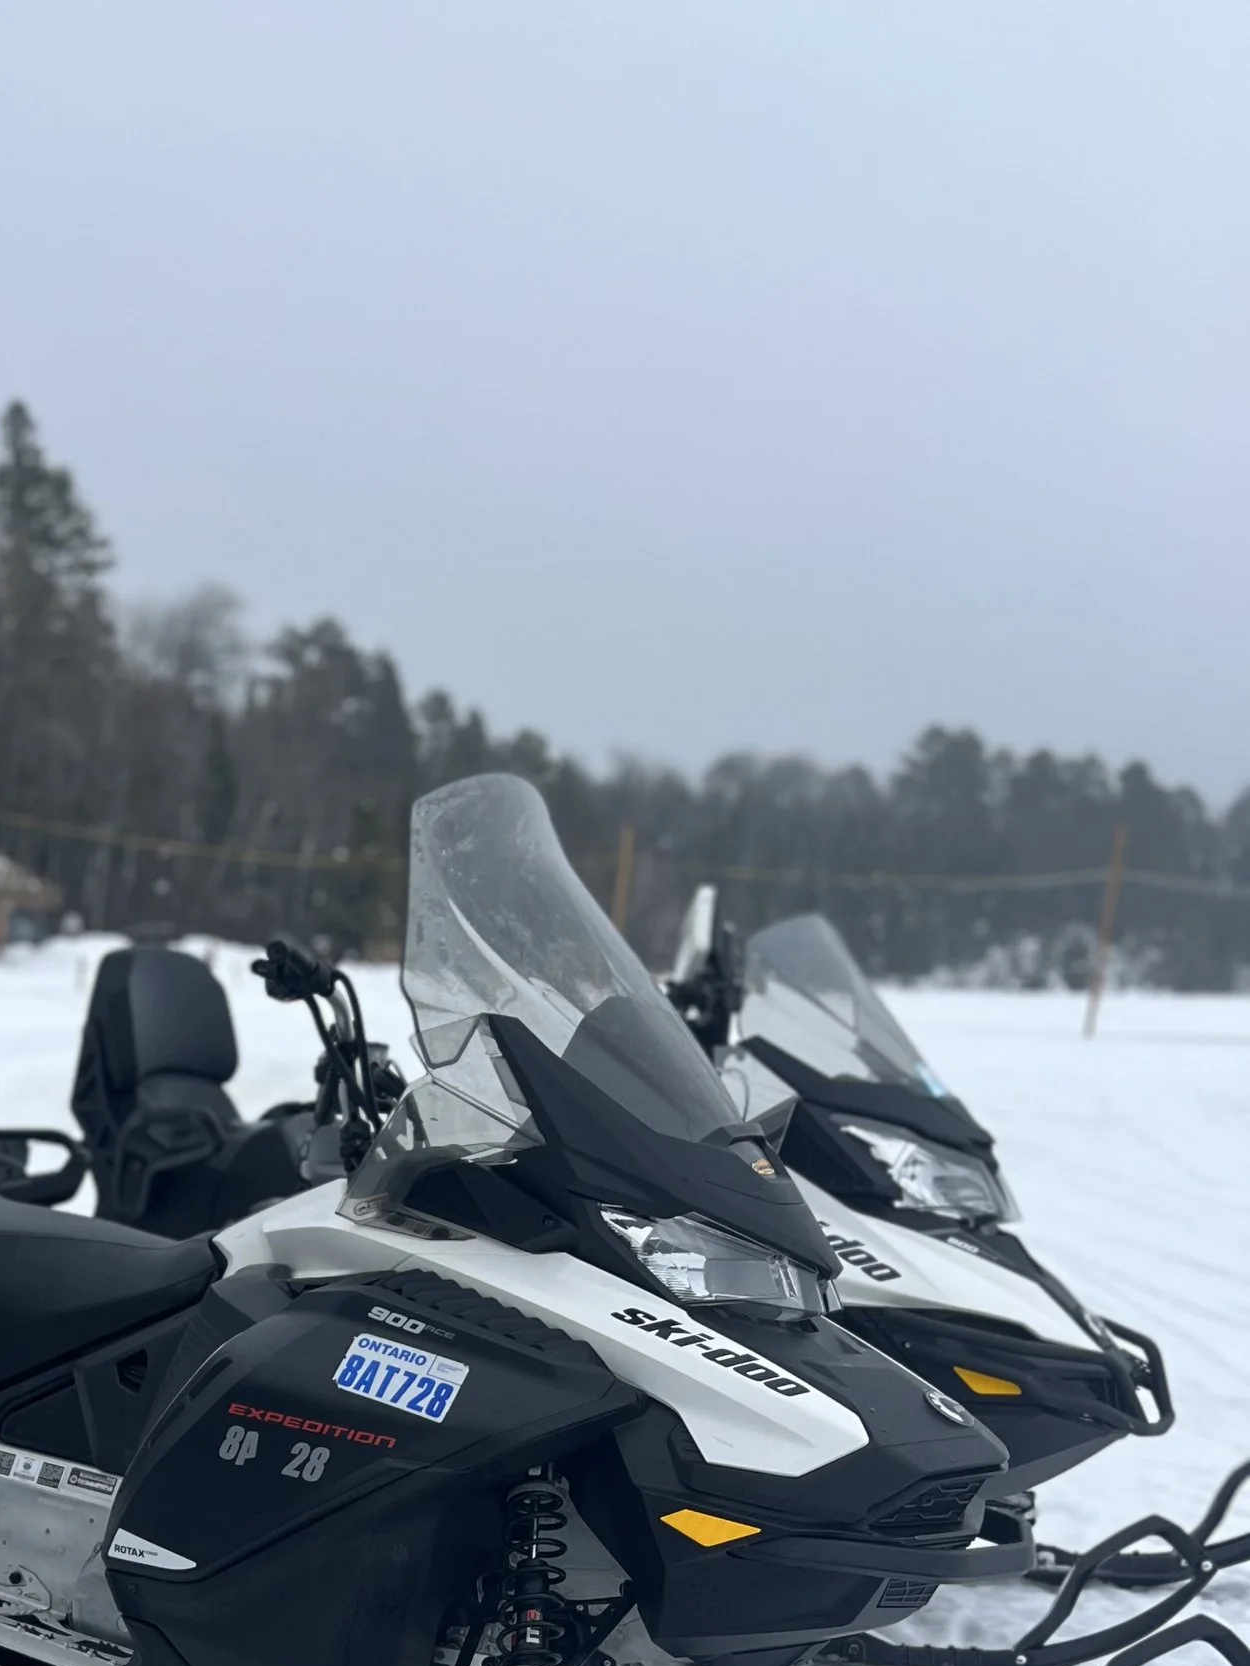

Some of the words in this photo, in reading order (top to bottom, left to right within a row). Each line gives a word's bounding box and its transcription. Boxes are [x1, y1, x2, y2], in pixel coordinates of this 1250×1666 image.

[358, 1338, 427, 1366] ONTARIO
[610, 1308, 811, 1396] ski-doo
[337, 1354, 454, 1418] 8AT728
[228, 1403, 396, 1448] EXPEDITION
[281, 1442, 330, 1482] 28
[114, 1544, 145, 1558] ROTAX
